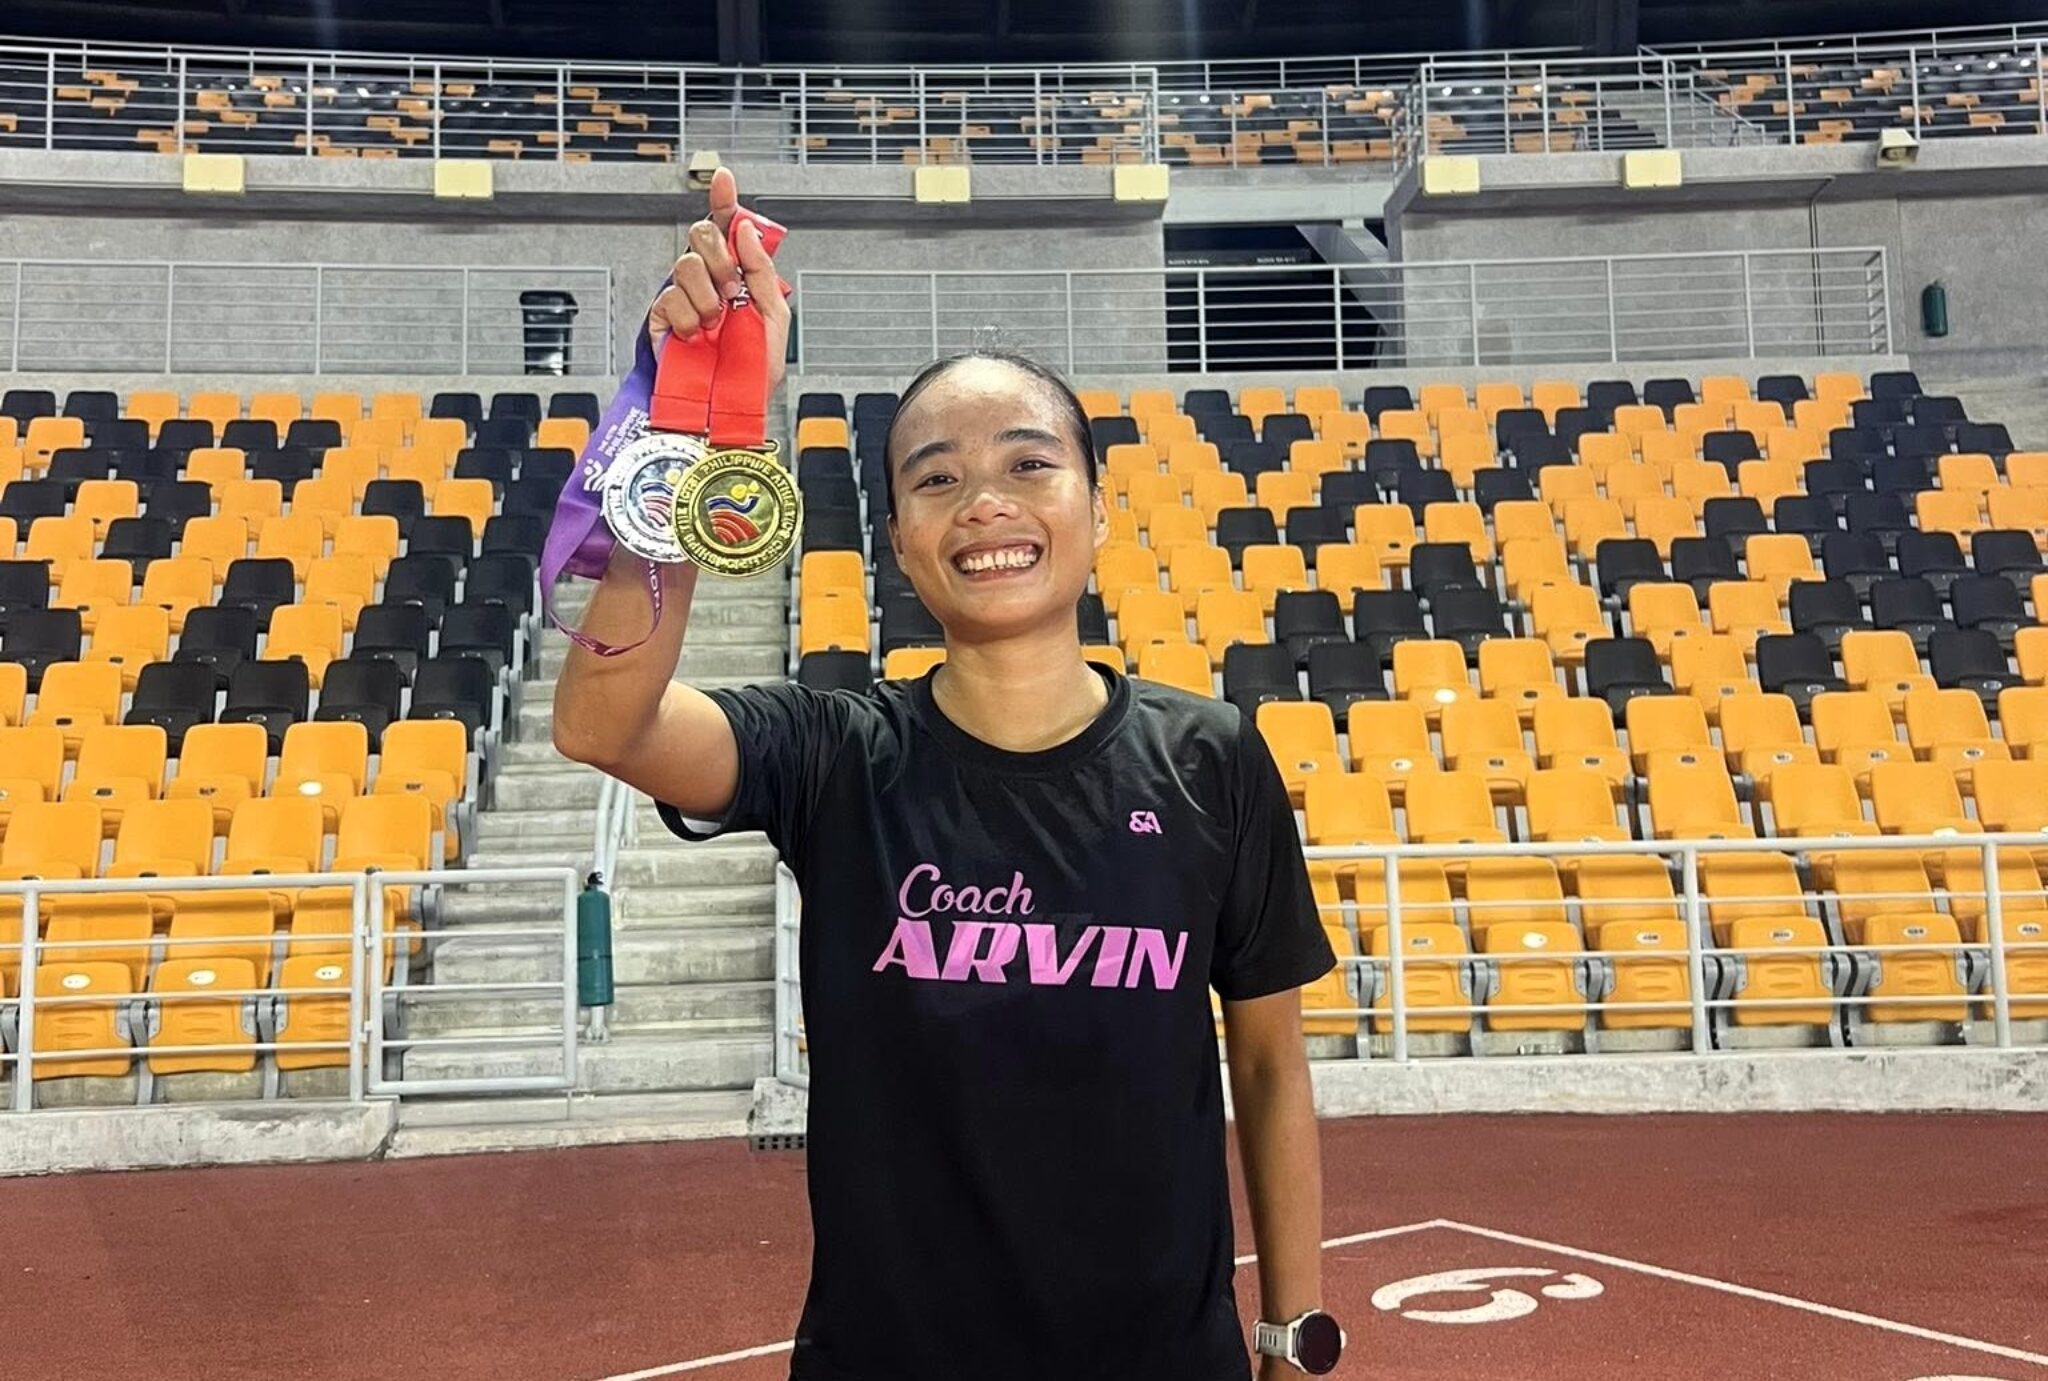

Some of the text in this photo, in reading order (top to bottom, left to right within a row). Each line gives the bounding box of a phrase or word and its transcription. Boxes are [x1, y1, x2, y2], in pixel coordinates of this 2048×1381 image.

[700, 455, 772, 476] PHILIPPINE
[898, 863, 1035, 918] Coach
[872, 917, 1189, 990] ARVIN
